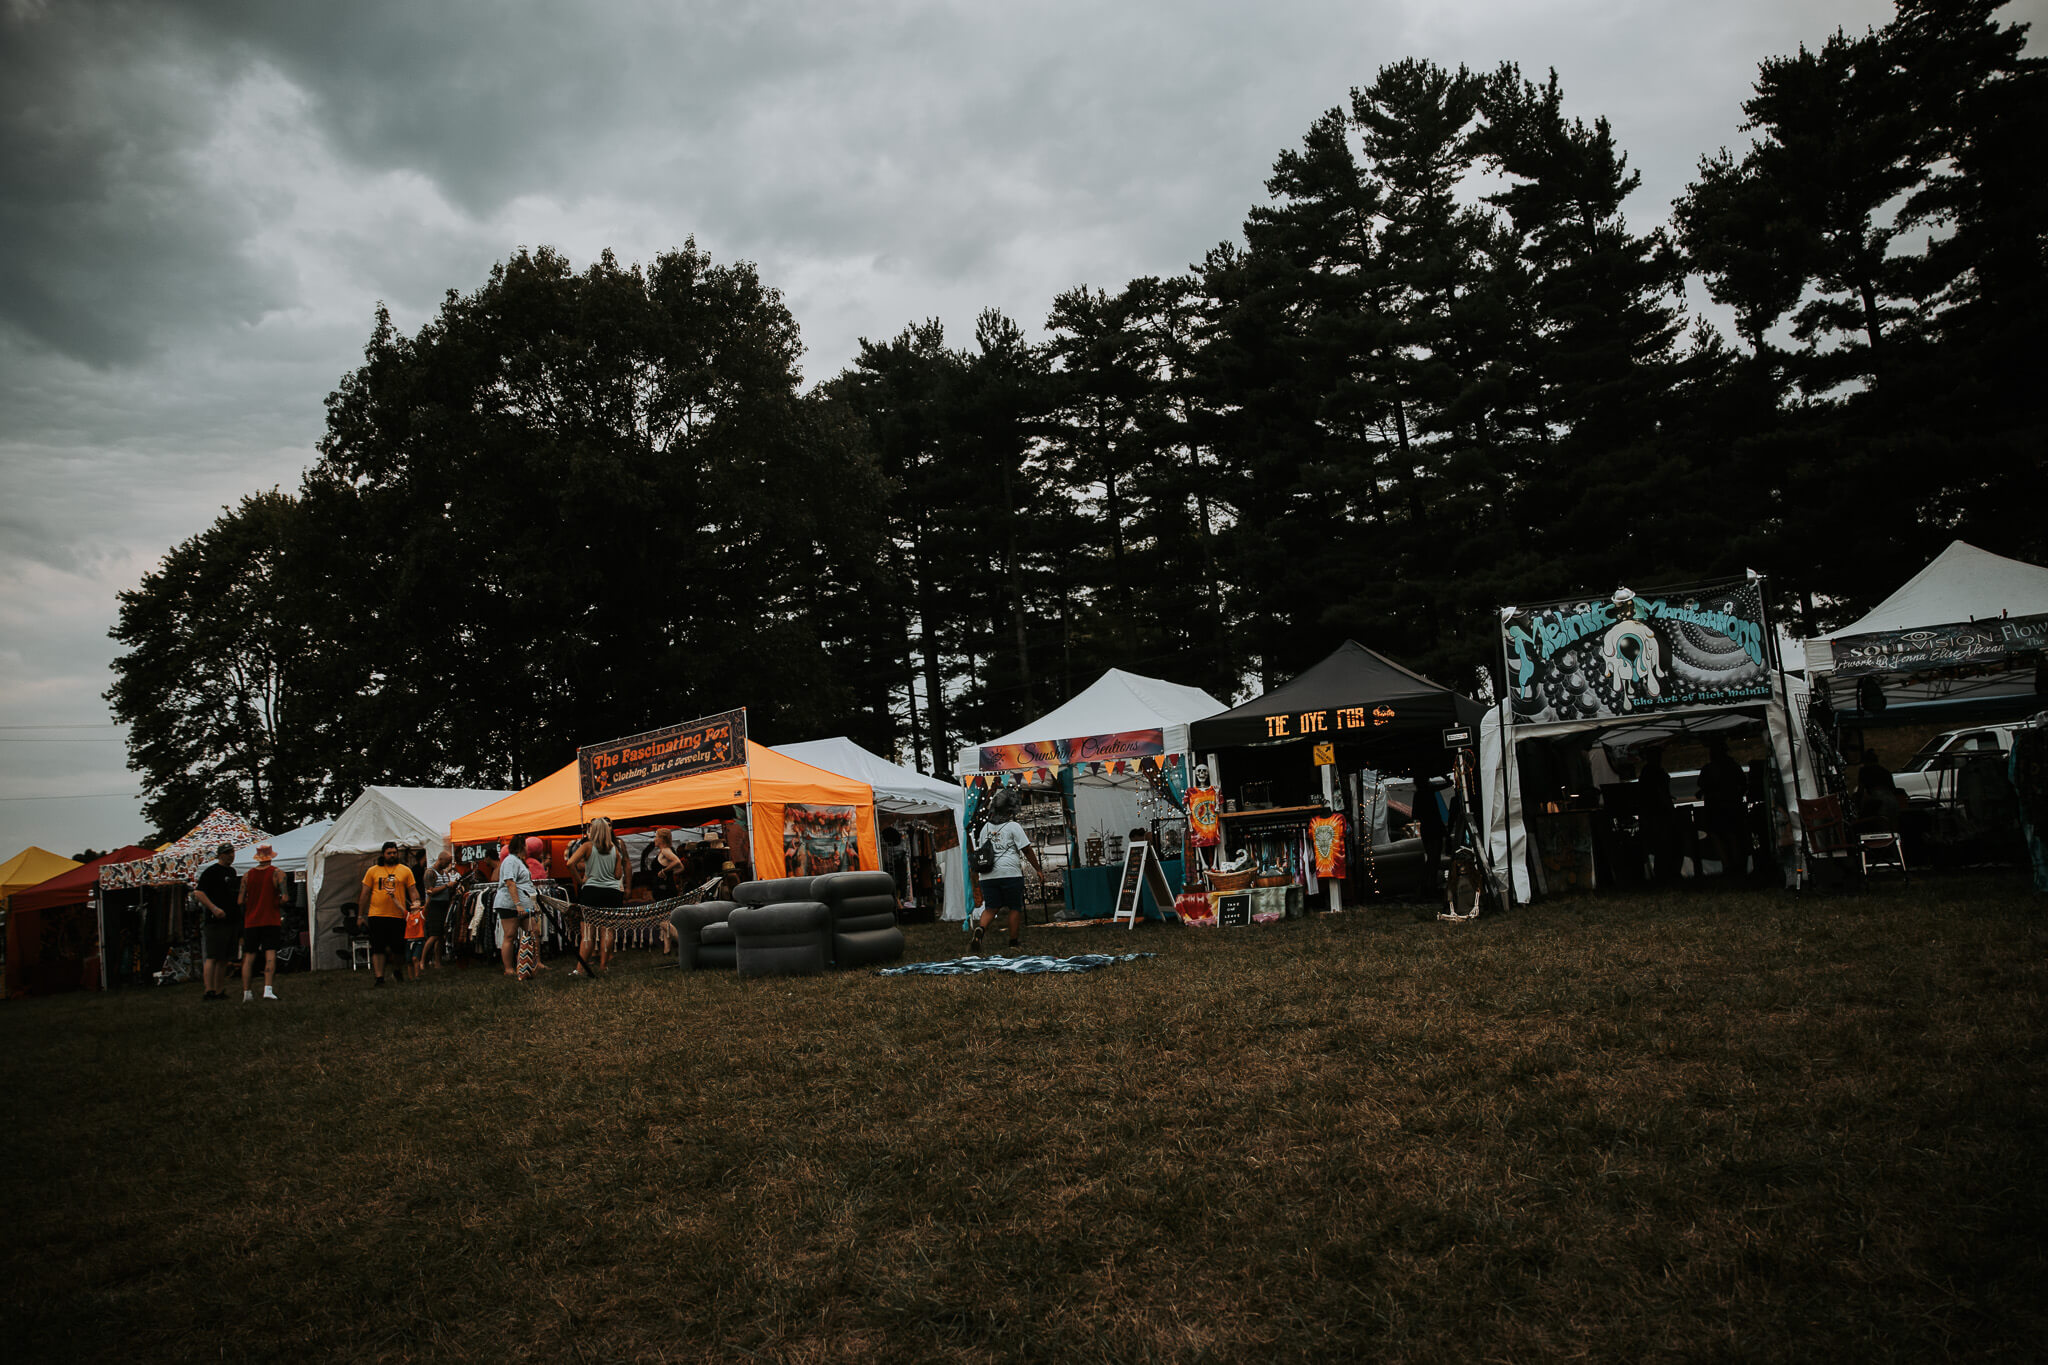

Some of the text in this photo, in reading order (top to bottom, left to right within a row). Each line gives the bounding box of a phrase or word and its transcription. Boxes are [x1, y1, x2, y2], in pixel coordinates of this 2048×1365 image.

[1509, 596, 1762, 685] Melnik Manifestations
[1911, 632, 1995, 651] VISION
[1632, 685, 1770, 707] The Art of Nick Melnik
[1264, 714, 1290, 738] TIE
[1299, 710, 1329, 734] DYE
[593, 755, 618, 770] The
[621, 733, 702, 764] Fascinating
[704, 726, 729, 742] Fox
[1017, 736, 1139, 765] Sunshine Creations
